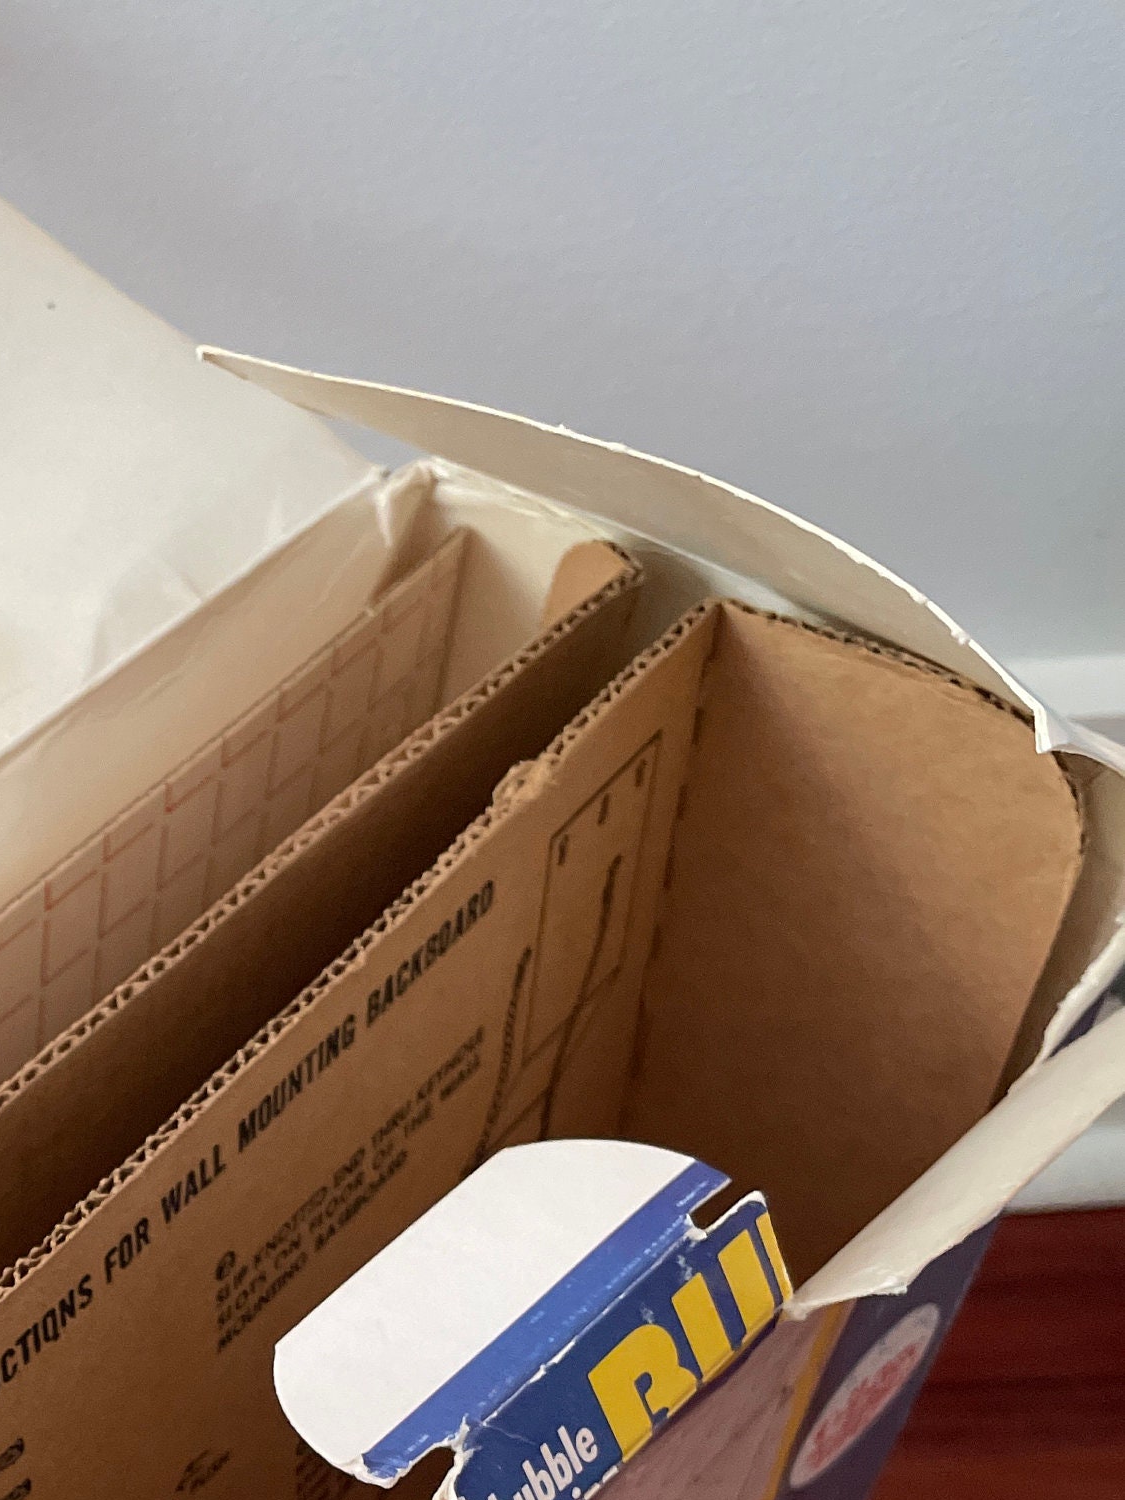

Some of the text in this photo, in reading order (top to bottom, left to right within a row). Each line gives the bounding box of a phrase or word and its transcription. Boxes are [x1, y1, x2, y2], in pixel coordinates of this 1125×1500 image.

[104, 1217, 152, 1284] FOR
[161, 1144, 227, 1225] WALL
[238, 1014, 356, 1153] MOUNTING
[366, 880, 495, 1030] BACKBOARD
